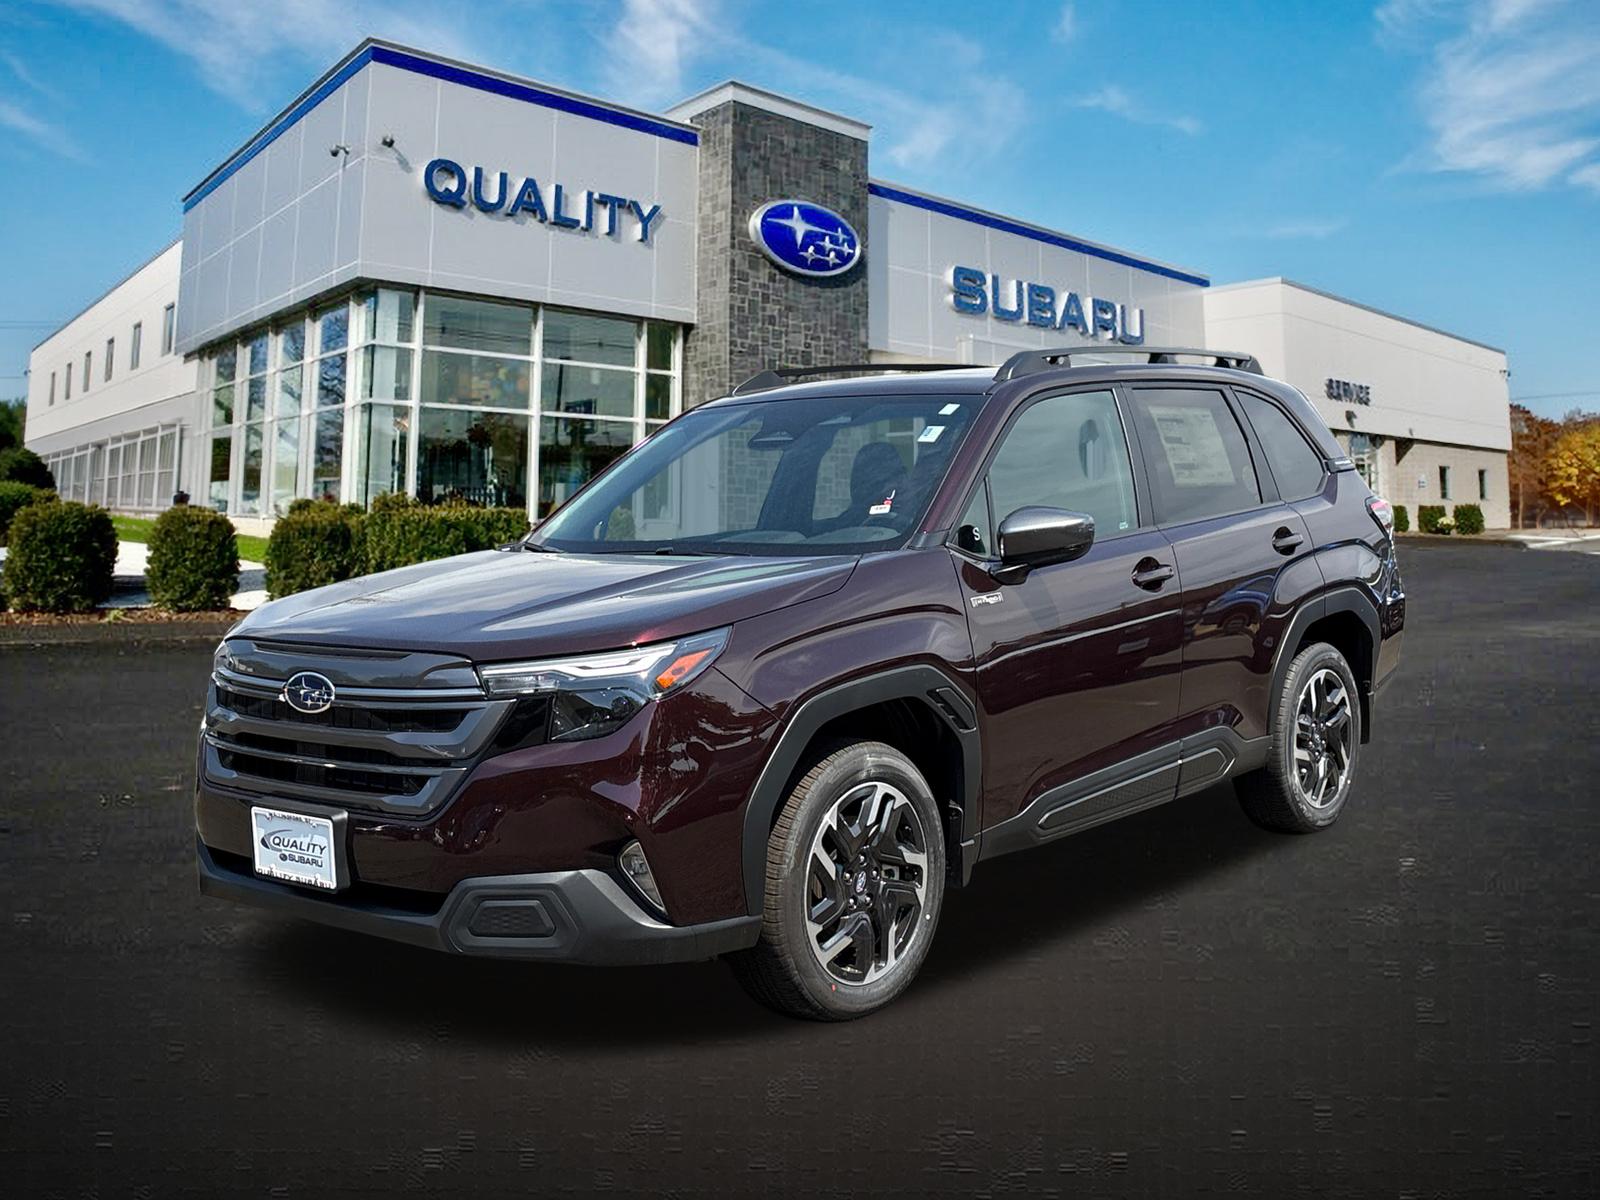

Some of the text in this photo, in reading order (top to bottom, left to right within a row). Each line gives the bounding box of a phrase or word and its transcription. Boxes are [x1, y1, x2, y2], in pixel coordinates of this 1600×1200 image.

[423, 158, 663, 243] QUALITY
[948, 265, 1145, 346] SUBARU
[1325, 378, 1371, 407] SERVICE
[272, 836, 326, 855] QUALITY
[288, 853, 323, 868] SUBARU
